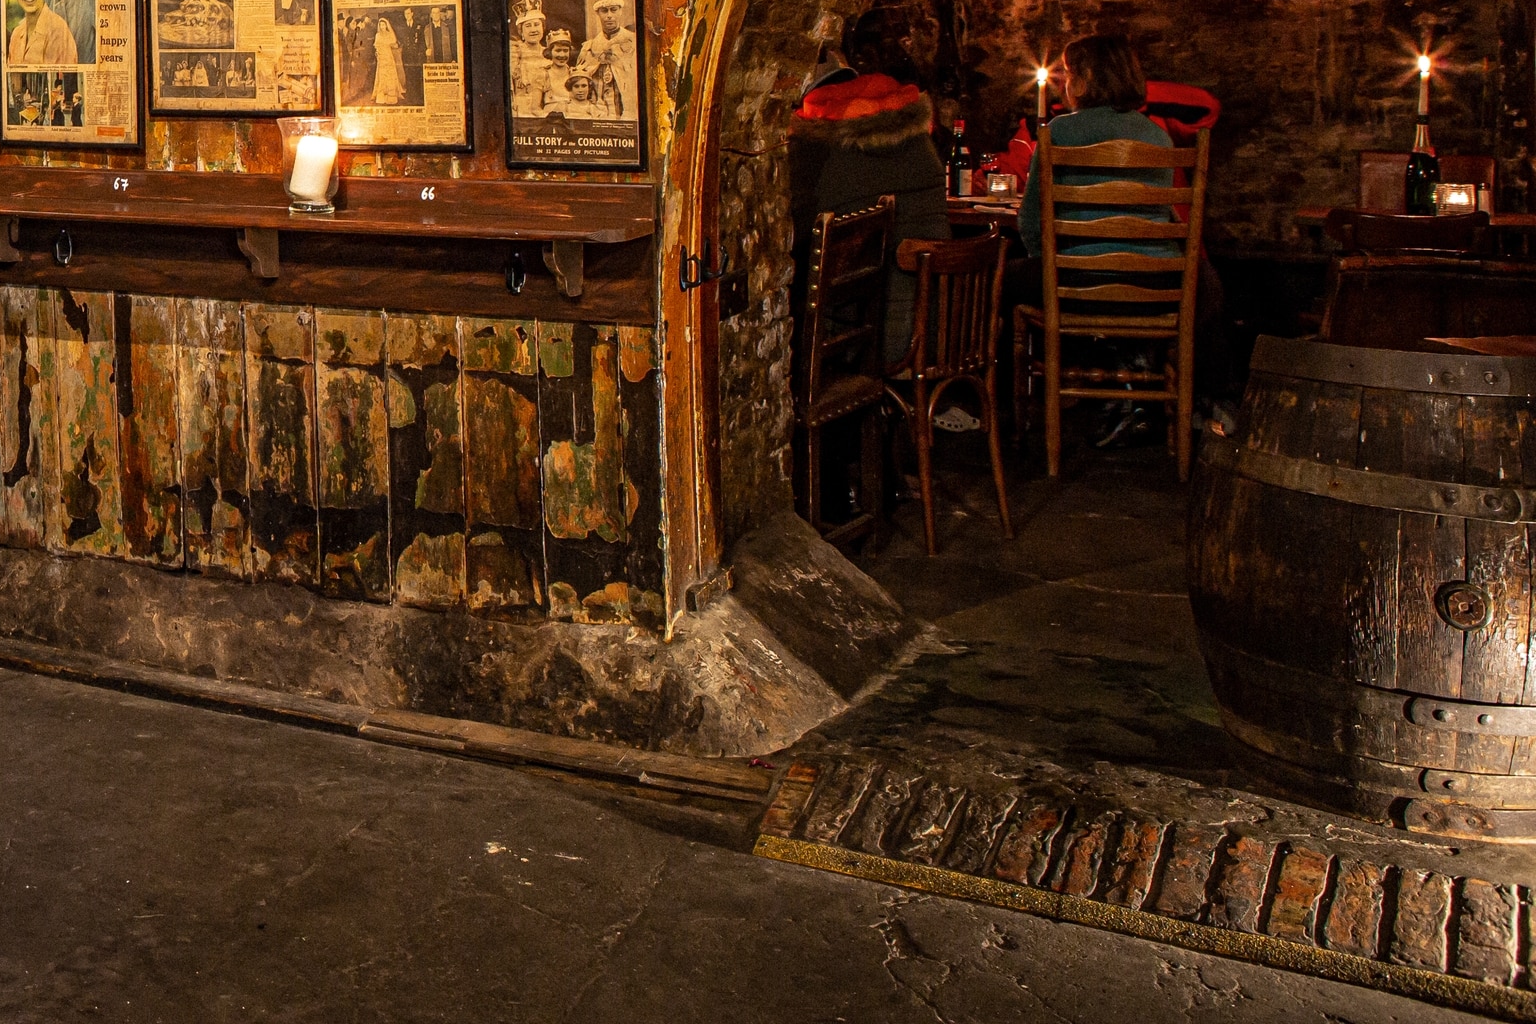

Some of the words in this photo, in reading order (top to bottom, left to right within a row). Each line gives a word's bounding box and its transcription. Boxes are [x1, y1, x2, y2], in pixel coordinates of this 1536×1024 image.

[99, 3, 126, 12] crown
[99, 19, 109, 28] 25
[100, 36, 128, 47] happy
[100, 54, 123, 64] years
[513, 136, 533, 145] FULL
[535, 136, 562, 146] STORY
[578, 138, 635, 147] CORONATION
[113, 177, 129, 191] 67
[421, 186, 435, 200] 66
